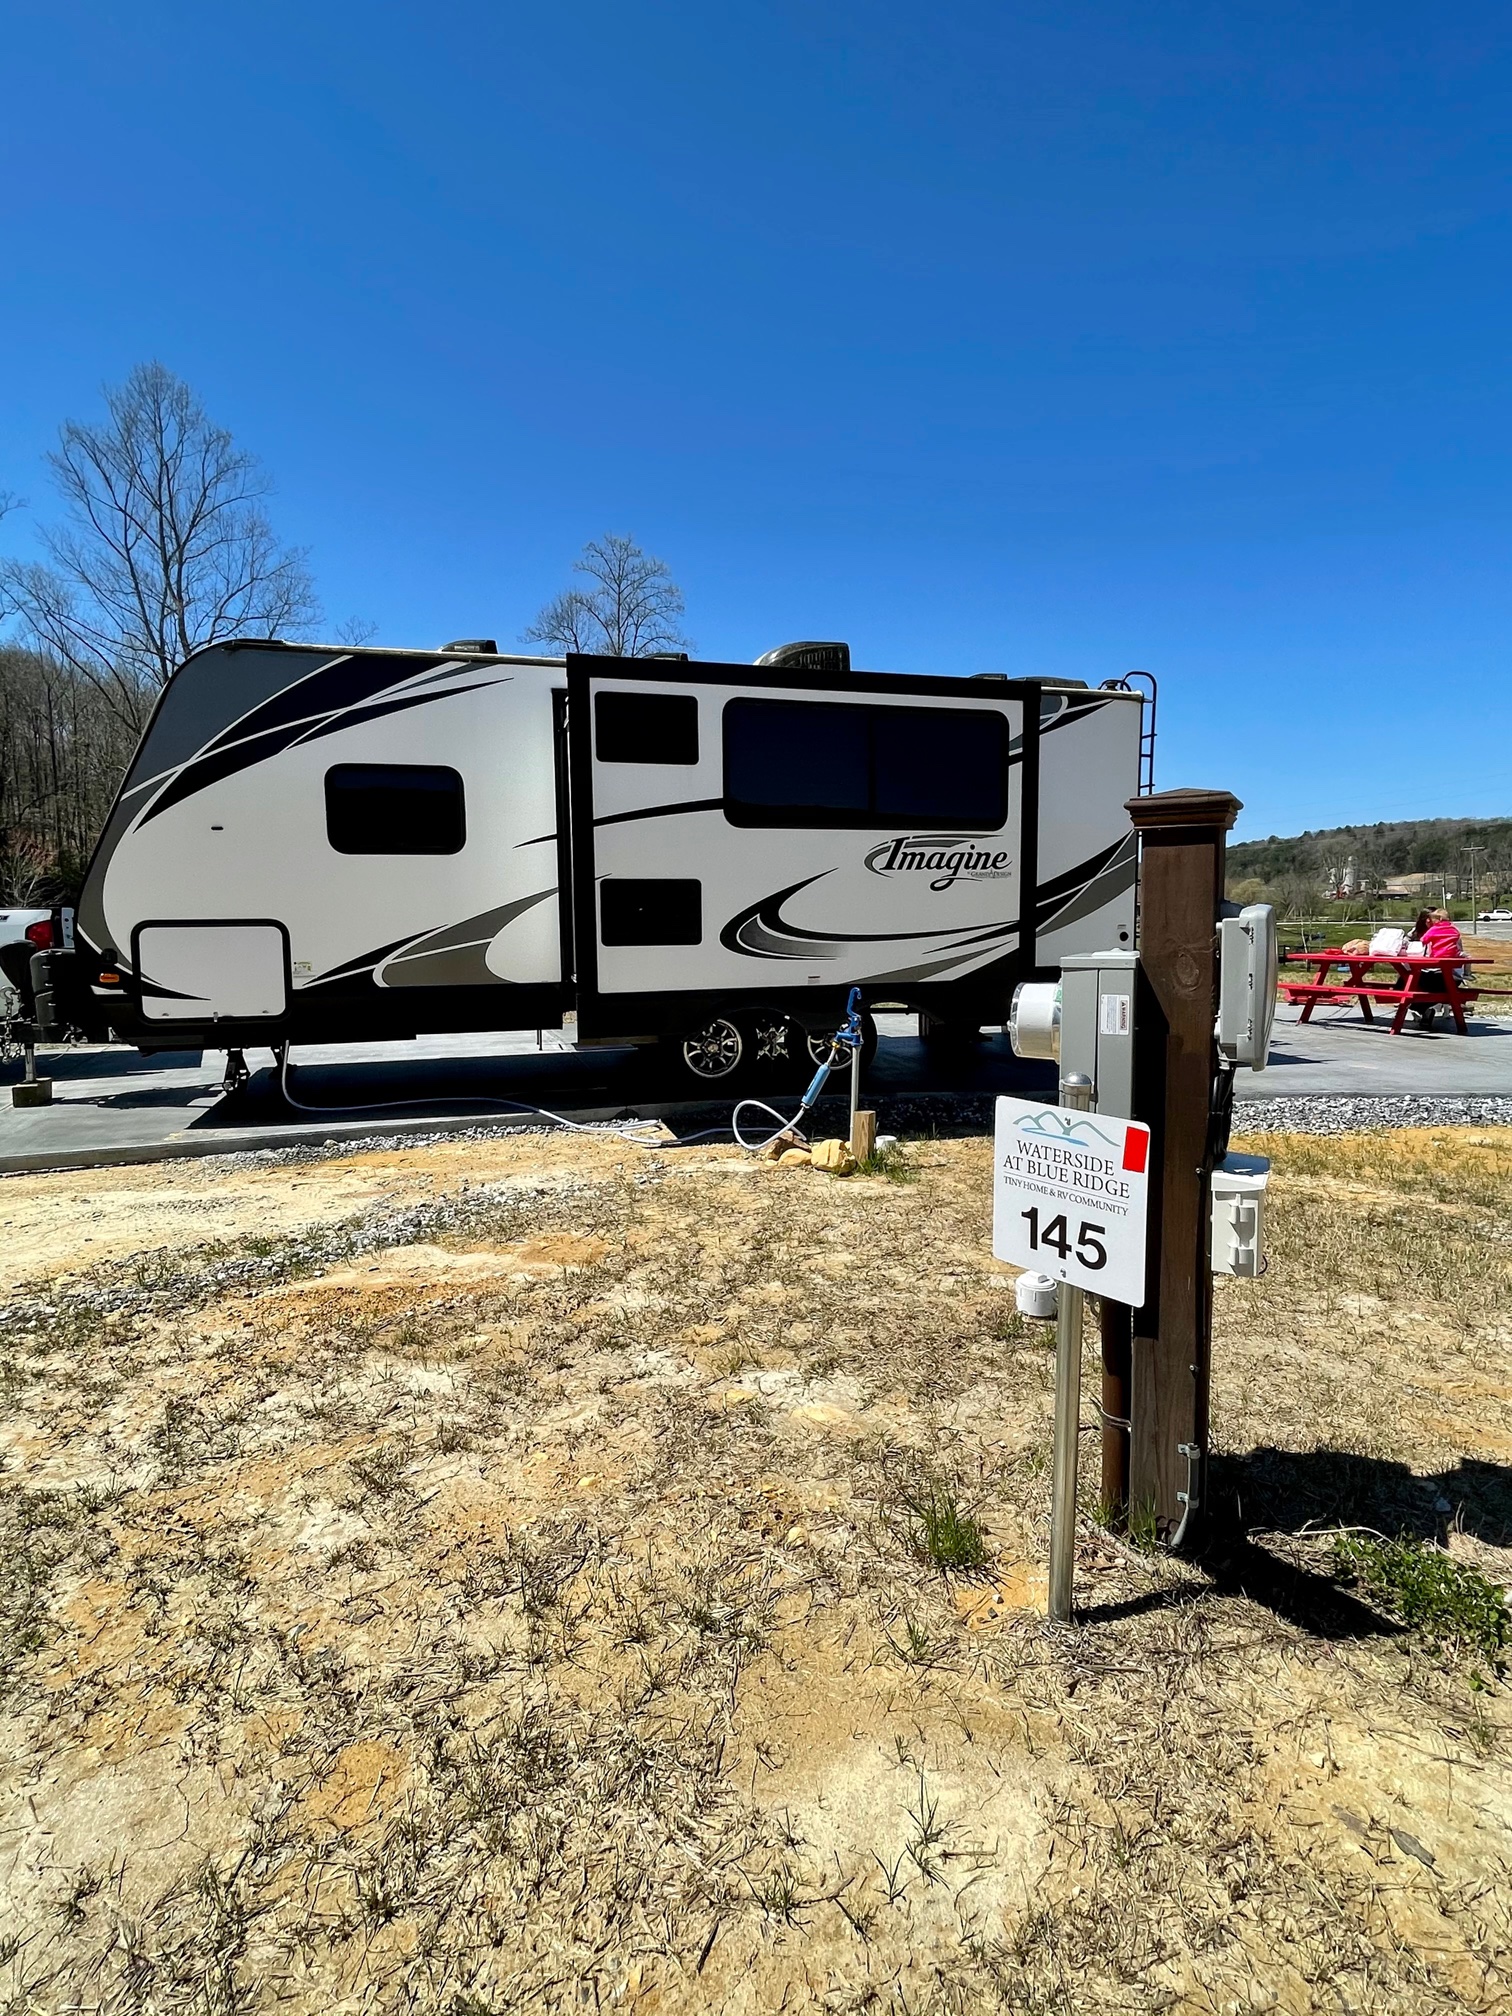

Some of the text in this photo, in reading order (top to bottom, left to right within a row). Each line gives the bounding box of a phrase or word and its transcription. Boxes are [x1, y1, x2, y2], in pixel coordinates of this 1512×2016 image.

[879, 836, 1013, 892] Imagine
[1003, 1154, 1131, 1199] AT BLUE RIDGE
[1017, 1140, 1114, 1176] WATERSIDE
[1004, 1176, 1129, 1216] TINY HOME & RV COMMUNITY
[1021, 1206, 1107, 1270] 145
